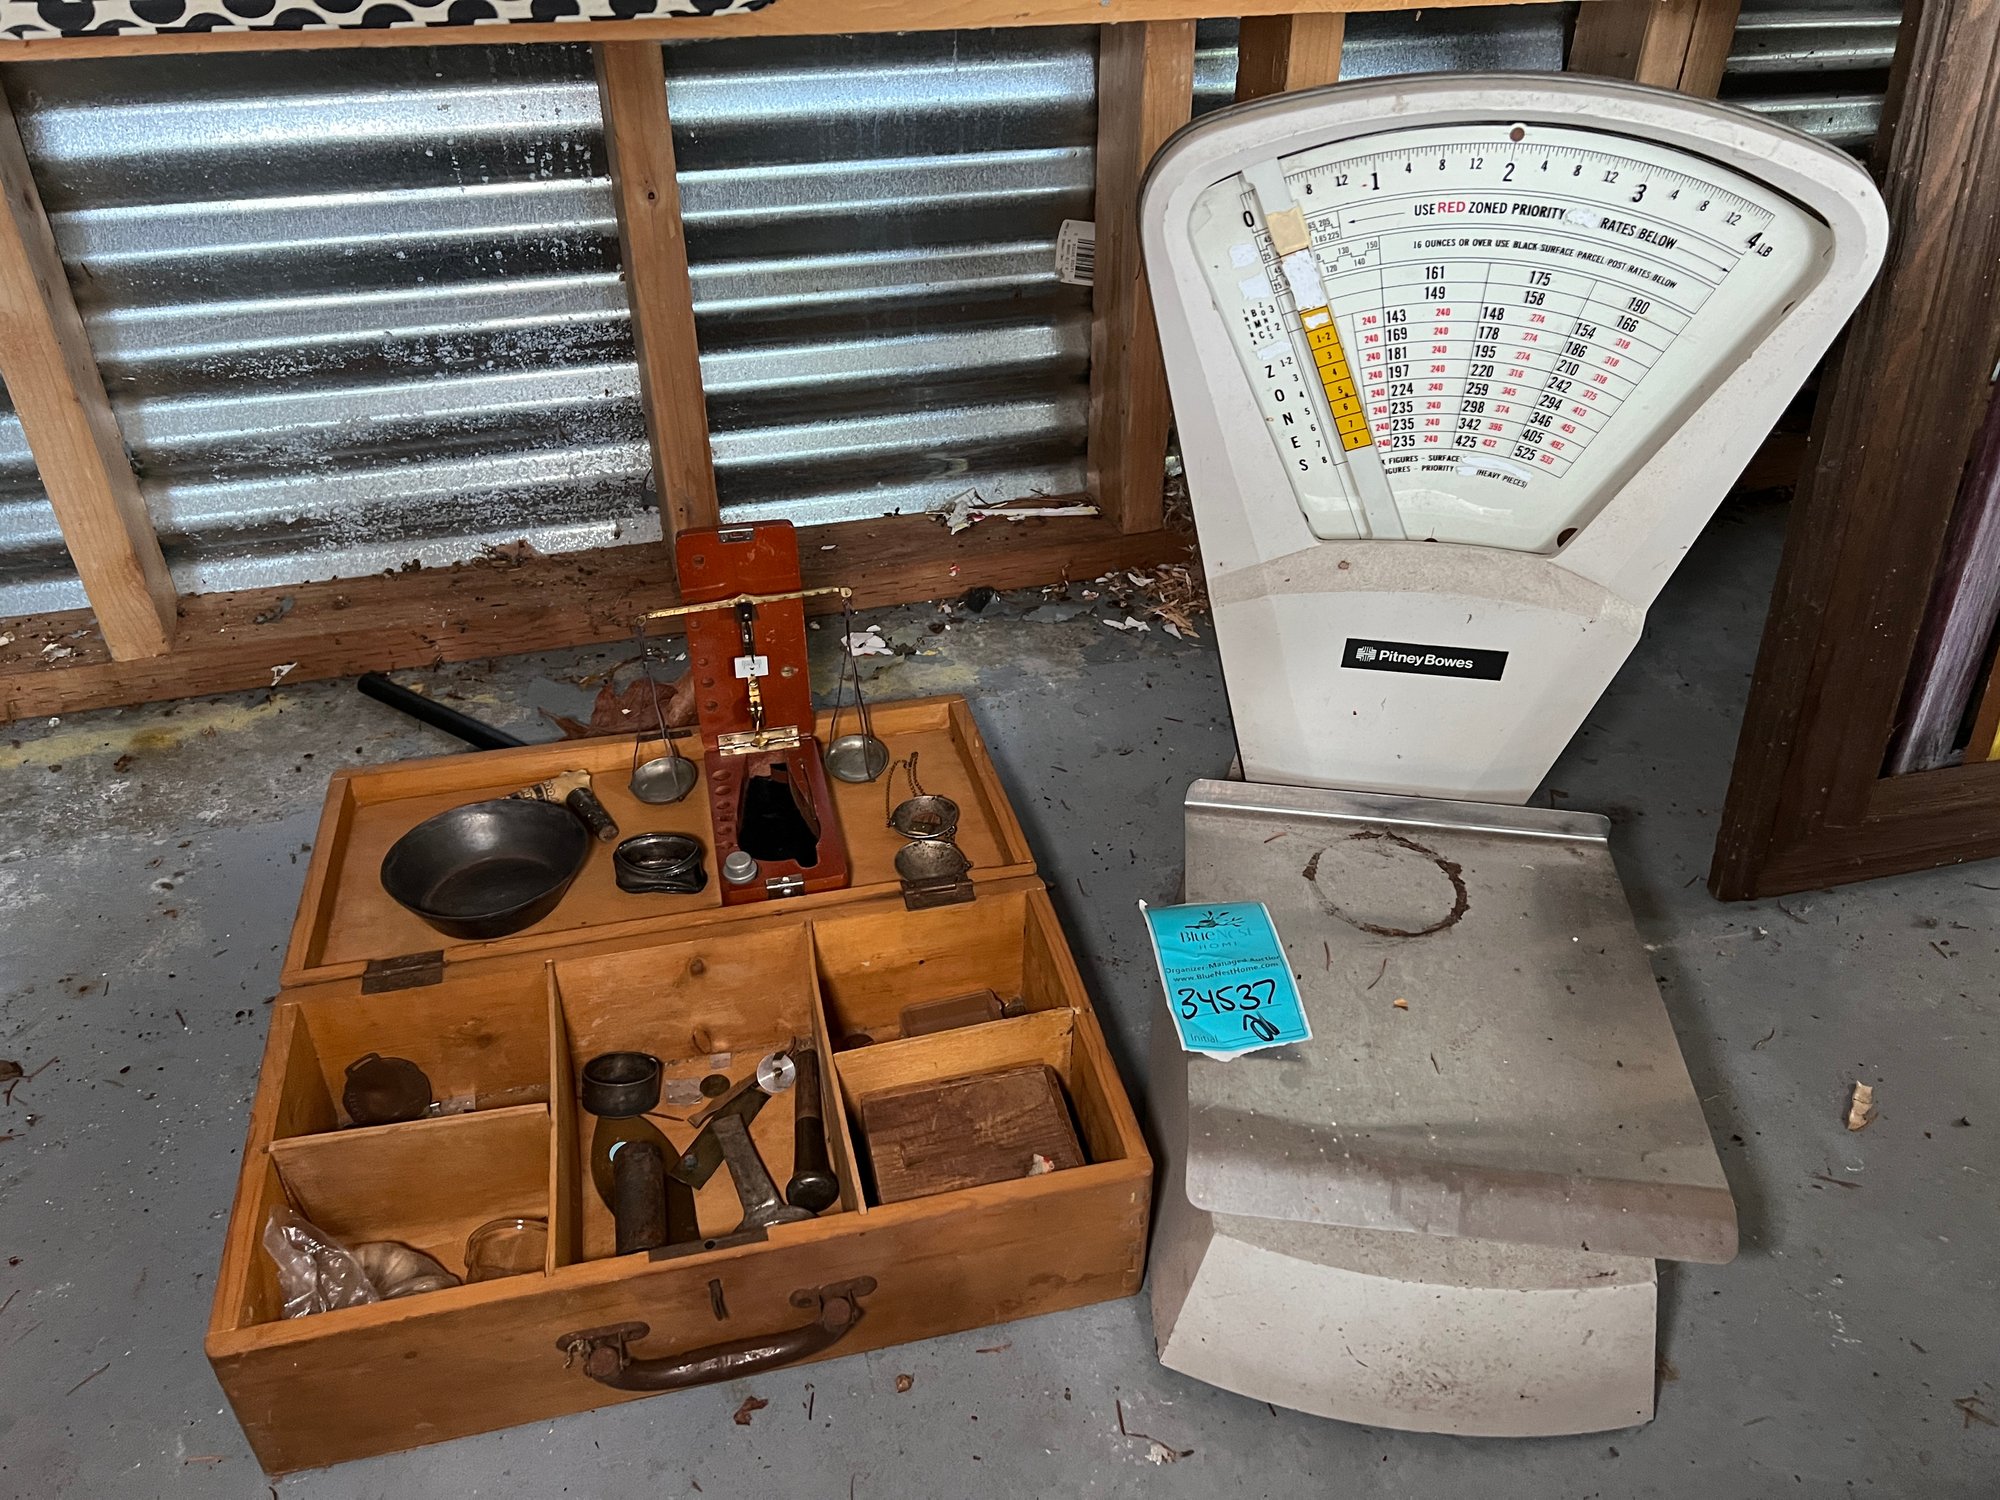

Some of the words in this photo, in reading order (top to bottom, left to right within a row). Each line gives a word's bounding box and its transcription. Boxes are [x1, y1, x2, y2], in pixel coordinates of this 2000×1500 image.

[1243, 210, 1254, 227] 0
[1306, 184, 1312, 195] 8
[1336, 175, 1348, 187] 12
[1371, 173, 1380, 190] 1
[1406, 163, 1412, 174] 4
[1439, 159, 1446, 170] 8
[1470, 158, 1484, 170] 12
[1503, 163, 1514, 182] 2
[1541, 161, 1548, 172] 4
[1573, 165, 1582, 176] 8
[1604, 170, 1618, 184] 12
[1632, 184, 1646, 203] 3
[1671, 189, 1680, 200] 4
[1700, 200, 1709, 212] 8
[1726, 212, 1742, 226] 12
[1747, 232, 1762, 250] 4
[1757, 243, 1773, 258] LB
[1414, 204, 1436, 216] USE
[1438, 202, 1466, 213] RED
[1468, 202, 1508, 214] ZONED
[1512, 203, 1566, 220] PRIORITY
[1600, 217, 1637, 236] RATES
[1638, 228, 1678, 250] BELOW
[1413, 240, 1422, 249] 16
[1424, 238, 1456, 248] OUNCES
[1458, 238, 1470, 246] OR
[1472, 239, 1492, 247] OVER
[1495, 239, 1510, 248] USE
[1512, 240, 1538, 251] BLACK
[1540, 244, 1574, 257] SURFACE
[1577, 250, 1605, 264] PARCEL
[1606, 259, 1627, 270] POST
[1628, 266, 1652, 279] RATES
[1652, 274, 1678, 289] BELOW
[1425, 265, 1445, 280] 161
[1530, 270, 1552, 286] 175
[1627, 296, 1651, 316] 190
[1268, 304, 1274, 314] 3
[1424, 286, 1446, 300] 149
[1524, 290, 1546, 306] 158
[1616, 315, 1640, 333] 166
[1275, 322, 1281, 331] 2
[1362, 316, 1377, 326] 240
[1386, 309, 1407, 324] 143
[1436, 308, 1451, 316] 240
[1482, 306, 1505, 321] 148
[1530, 313, 1546, 324] 274
[1574, 322, 1597, 340] 154
[1616, 338, 1631, 350] 318
[1317, 332, 1331, 343] 1-2
[1364, 334, 1379, 344] 240
[1387, 326, 1408, 342] 169
[1434, 326, 1449, 336] 240
[1479, 326, 1500, 340] 178
[1522, 332, 1538, 342] 274
[1565, 341, 1588, 358] 186
[1604, 356, 1620, 368] 318
[1280, 356, 1292, 367] 1-2
[1327, 352, 1332, 360] 3
[1366, 352, 1381, 362] 240
[1388, 346, 1408, 361] 181
[1432, 346, 1447, 354] 240
[1475, 344, 1497, 358] 195
[1515, 352, 1531, 361] 274
[1556, 359, 1580, 376] 210
[1593, 373, 1608, 385] 318
[1332, 368, 1338, 376] 4
[1292, 374, 1299, 382] 3
[1368, 370, 1382, 380] 240
[1389, 364, 1409, 379] 197
[1430, 364, 1446, 373] 240
[1470, 364, 1494, 378] 220
[1548, 376, 1572, 394] 242
[1583, 389, 1598, 401] 375
[1299, 390, 1304, 398] 4
[1338, 386, 1343, 394] 5
[1370, 388, 1386, 398] 240
[1391, 382, 1414, 396] 224
[1428, 382, 1444, 392] 240
[1466, 382, 1490, 396] 259
[1502, 386, 1517, 396] 345
[1539, 394, 1564, 411] 294
[1304, 408, 1310, 416] 5
[1373, 406, 1388, 414] 240
[1391, 400, 1414, 414] 235
[1426, 401, 1442, 410] 240
[1462, 400, 1486, 414] 298
[1494, 404, 1510, 414] 374
[1530, 412, 1554, 428] 346
[1310, 424, 1316, 432] 6
[1348, 420, 1353, 428] 7
[1376, 422, 1390, 432] 240
[1392, 418, 1414, 431] 235
[1425, 418, 1440, 426] 240
[1458, 418, 1482, 431] 342
[1522, 428, 1545, 444] 405
[1316, 440, 1320, 448] 7
[1354, 436, 1358, 444] 8
[1377, 439, 1392, 448] 240
[1393, 434, 1416, 448] 235
[1424, 435, 1439, 443] 240
[1455, 434, 1478, 448] 425
[1514, 445, 1538, 461] 525
[1322, 456, 1328, 464] 8
[1388, 455, 1419, 465] FIGURES
[1385, 466, 1411, 475] IGURES
[1421, 464, 1455, 472] PRIORITY
[1476, 469, 1501, 480] (HEAVY
[1173, 962, 1279, 982] www.BlueNestHome.com
[1178, 979, 1276, 1020] 34537
[1190, 1034, 1218, 1044] Initial
